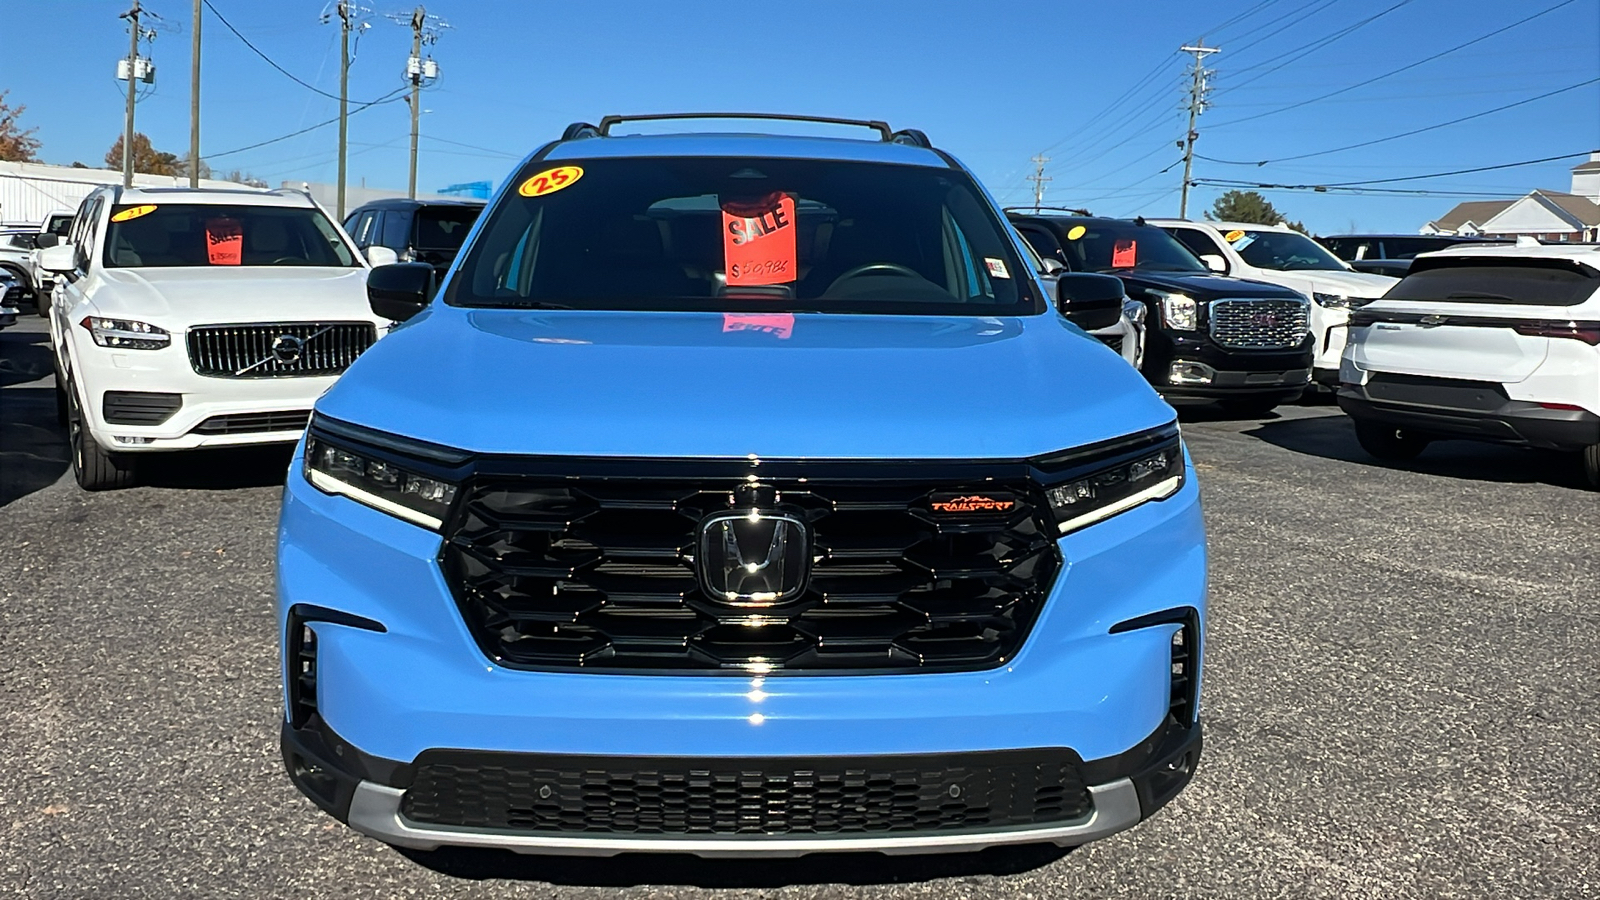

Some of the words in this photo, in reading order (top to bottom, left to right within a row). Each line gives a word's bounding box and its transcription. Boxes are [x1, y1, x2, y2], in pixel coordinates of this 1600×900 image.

[531, 169, 569, 194] 25
[128, 207, 142, 219] 21
[728, 202, 789, 245] SALE
[931, 502, 1014, 512] TRAILSPORT
